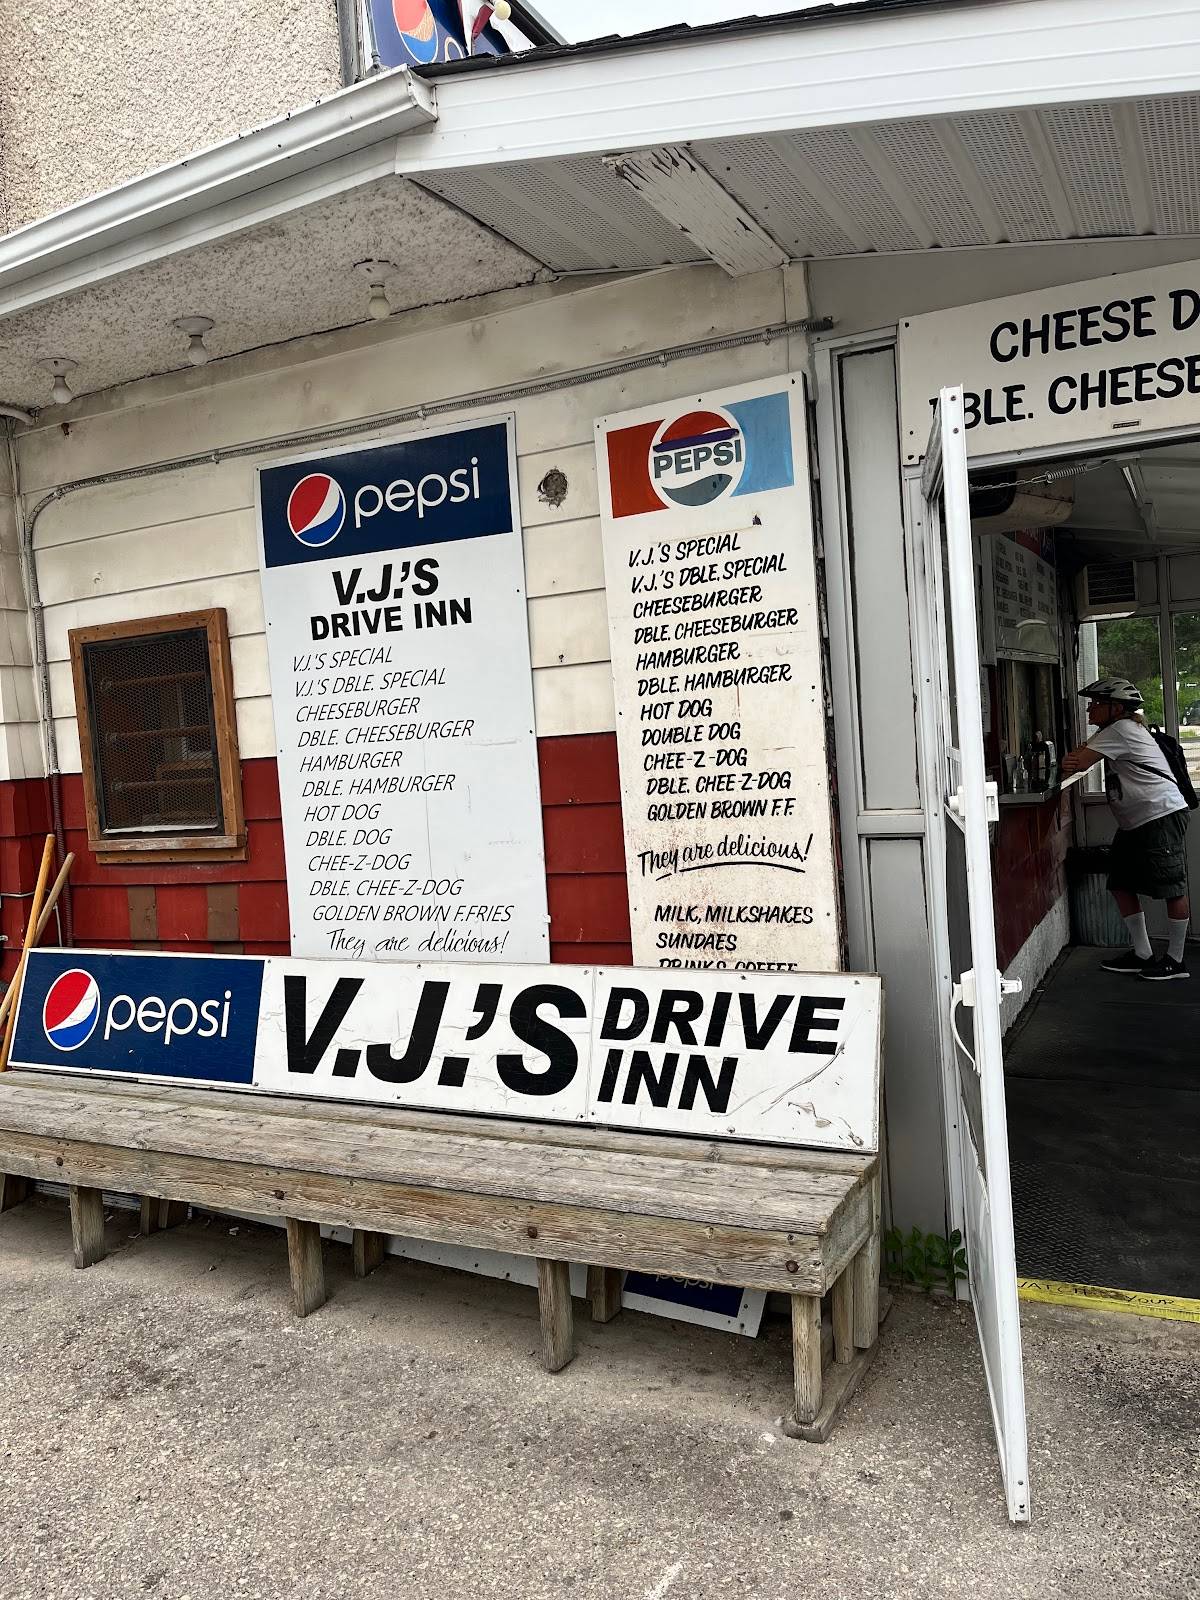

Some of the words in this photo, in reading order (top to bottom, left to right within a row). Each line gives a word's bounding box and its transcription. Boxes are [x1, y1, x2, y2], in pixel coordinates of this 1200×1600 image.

[990, 295, 1156, 362] CHEESE
[929, 384, 1034, 430] BLE.
[653, 439, 742, 479] PEPSI
[354, 457, 480, 528] pepsi
[628, 543, 671, 568] V.J.'S
[676, 533, 741, 561] SPECIAL
[332, 558, 440, 606] V.J.'S
[631, 570, 674, 594] V.J.'S
[679, 564, 721, 587] DBLE.
[723, 553, 787, 580] SPECIAL
[633, 585, 762, 619] CHEESEBURGER
[310, 606, 403, 640] DRIVE
[414, 597, 472, 629] INN
[634, 624, 671, 645] DBLE.
[674, 608, 798, 640] CHEESEBURGER
[293, 653, 327, 672] V.J.'S
[330, 646, 392, 667] SPECIAL
[636, 642, 740, 671] HAMBURGER
[295, 678, 329, 697] V.J.'S
[332, 674, 375, 695] DBLE.
[380, 668, 446, 690] SPECIAL
[637, 675, 680, 697] DBLE.
[684, 664, 792, 692] HAMBURGER
[296, 697, 420, 722] CHEESEBURGER
[641, 702, 674, 721] HOT
[677, 699, 713, 718] DOG
[298, 730, 339, 748] DBLE.
[345, 719, 474, 744] CHEESEBURGER
[641, 725, 704, 746] DOUBLE
[708, 722, 741, 741] DOG
[300, 751, 402, 772] HAMBURGER
[302, 780, 343, 797] DBLE.
[349, 774, 456, 796] HAMBURGER
[646, 777, 690, 795] DBLE.
[695, 771, 792, 793] CHEE-Z-DOG
[304, 805, 340, 822] HOT
[342, 803, 381, 821] DOG
[647, 802, 707, 821] GOLDEN
[711, 799, 768, 819] BROWN
[771, 798, 796, 816] F.F.
[306, 830, 347, 847] DBLE.
[353, 829, 392, 846] DOG
[308, 853, 412, 872] CHEE-Z-DOG
[637, 844, 679, 876] They
[682, 843, 713, 863] are
[717, 833, 813, 863] delicious!
[309, 880, 350, 896] DBLE.
[356, 879, 464, 895] CHEE-Z-DOG
[312, 905, 381, 921] GOLDEN
[383, 905, 451, 921] BROWN
[654, 905, 701, 925] MILK,
[705, 905, 813, 924] MILKSHAKES
[326, 928, 365, 959] They
[374, 937, 410, 952] are
[417, 928, 510, 953] delicious!
[656, 932, 737, 951] SUNDAES
[104, 989, 232, 1045] pepsi
[283, 975, 587, 1097] V.J.'S
[600, 987, 846, 1055] DRIVE
[597, 1049, 738, 1113] INN
